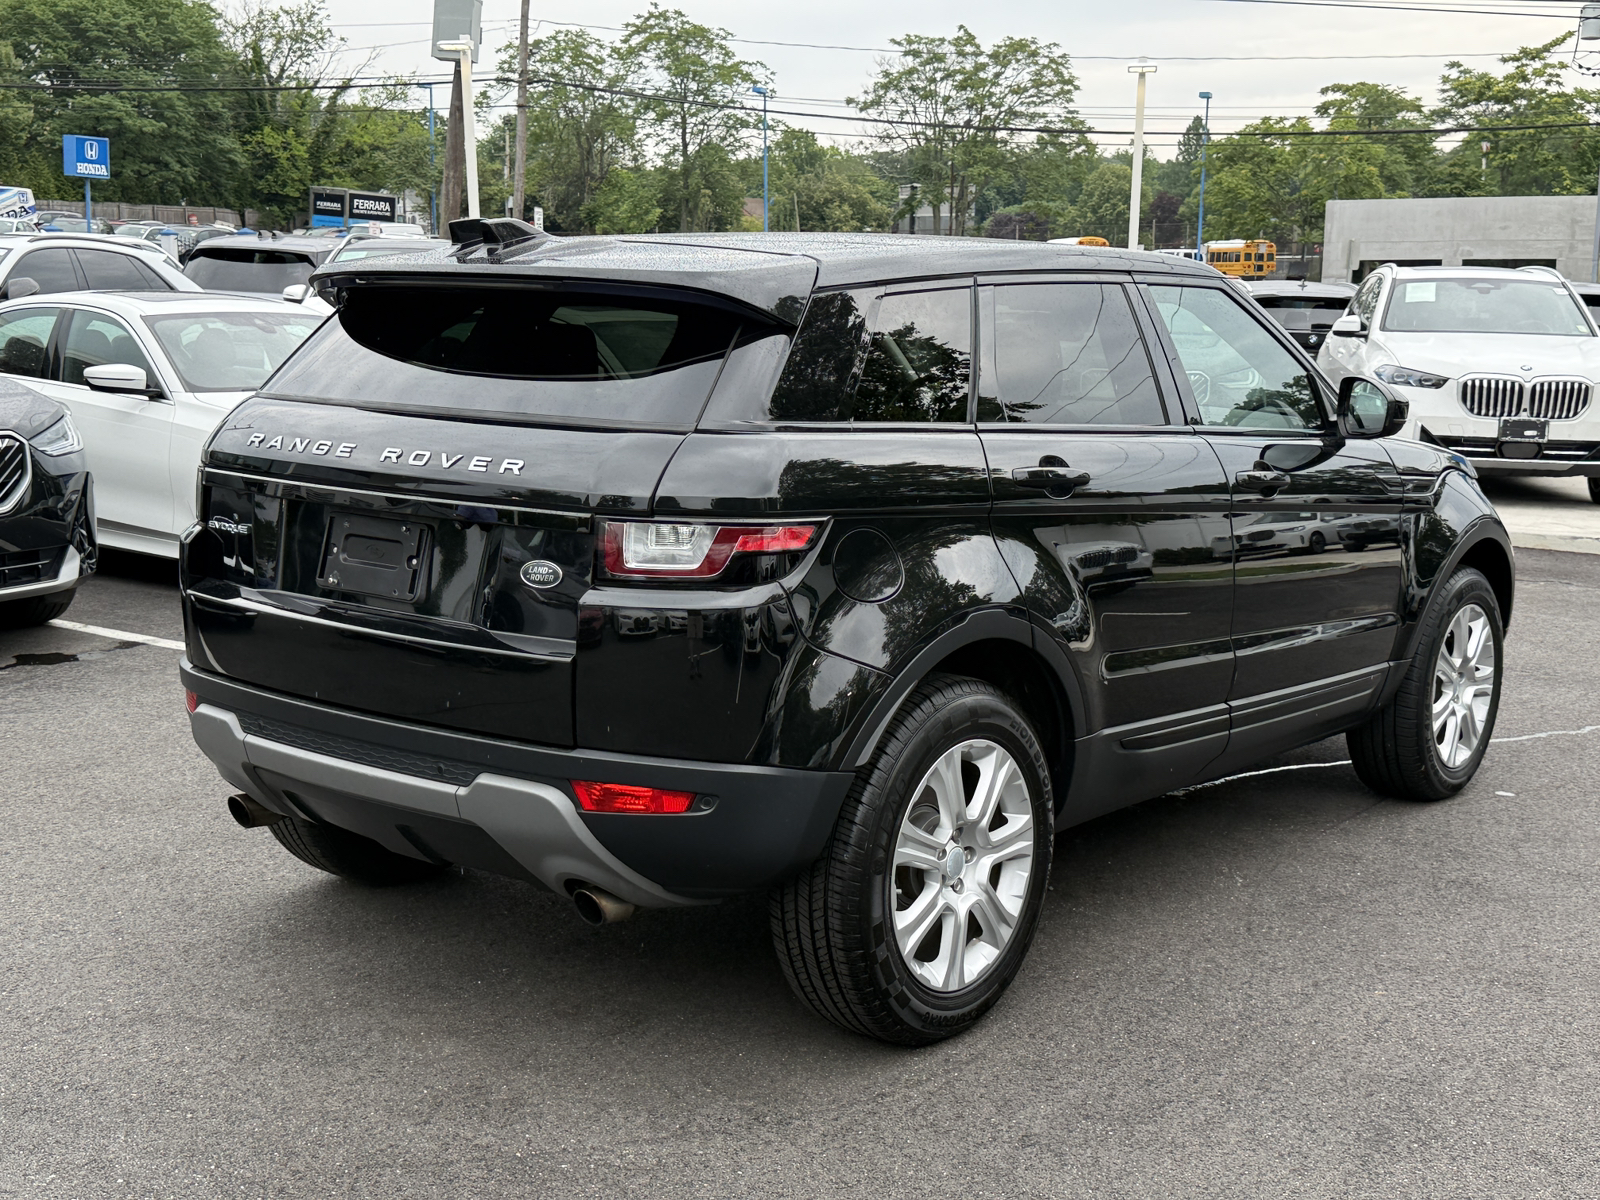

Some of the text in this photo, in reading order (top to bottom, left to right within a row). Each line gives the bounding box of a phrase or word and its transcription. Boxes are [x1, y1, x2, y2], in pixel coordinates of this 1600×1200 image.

[76, 163, 108, 176] HONDA
[353, 199, 391, 211] FERRARA
[247, 432, 525, 475] RANGE ROVER
[208, 520, 249, 535] EVOQUE
[529, 566, 549, 574] LAND
[530, 574, 555, 582] ROVER
